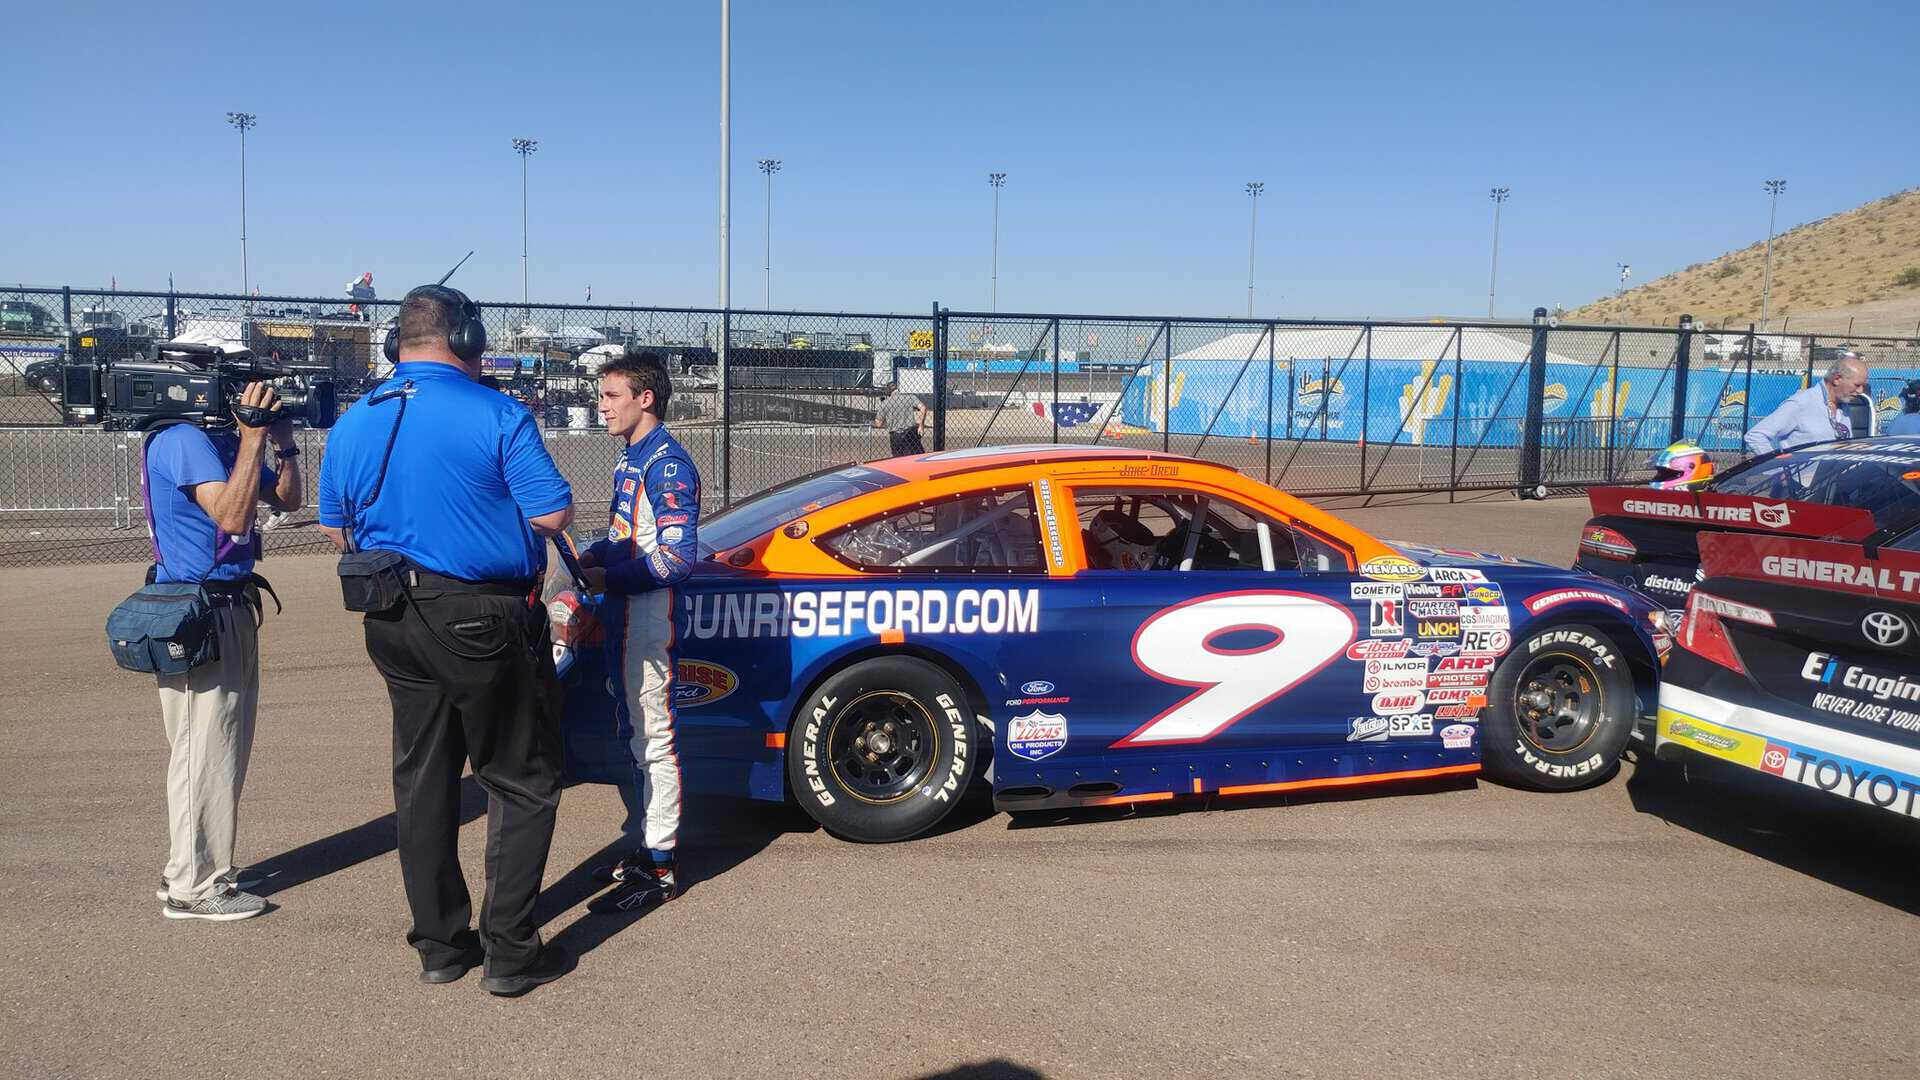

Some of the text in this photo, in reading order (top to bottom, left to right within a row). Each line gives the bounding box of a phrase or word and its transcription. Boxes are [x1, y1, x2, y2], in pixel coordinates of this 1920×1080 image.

[1623, 499, 1704, 519] GENERAL
[1705, 505, 1752, 521] TIRE
[1360, 564, 1428, 575] MENARDS
[1434, 569, 1468, 581] ARCA
[1762, 555, 1920, 593] GENERAL T
[1404, 583, 1441, 597] Holley
[1644, 574, 1696, 593] distribu
[1410, 601, 1456, 612] QUARTER
[1418, 608, 1458, 616] MASTER
[1418, 622, 1460, 636] UNOH
[1528, 631, 1616, 669] GENERAL
[1108, 589, 1358, 749] 9
[1383, 663, 1426, 671] ILMOR
[1439, 658, 1494, 670] ARP
[1382, 678, 1424, 688] brembo
[1429, 674, 1486, 682] PYROTECT
[1428, 690, 1471, 701] COMP
[1006, 699, 1022, 707] FORD
[1812, 692, 1853, 716] NEVER
[1852, 701, 1890, 724] LOSE
[1016, 727, 1062, 740] LUCAS
[804, 695, 838, 807] GENERAL
[934, 693, 968, 803] GENERAL
[1025, 741, 1063, 749] PRODUCTS
[1515, 740, 1604, 778] GENERAL
[1795, 751, 1920, 815] TOYOT
